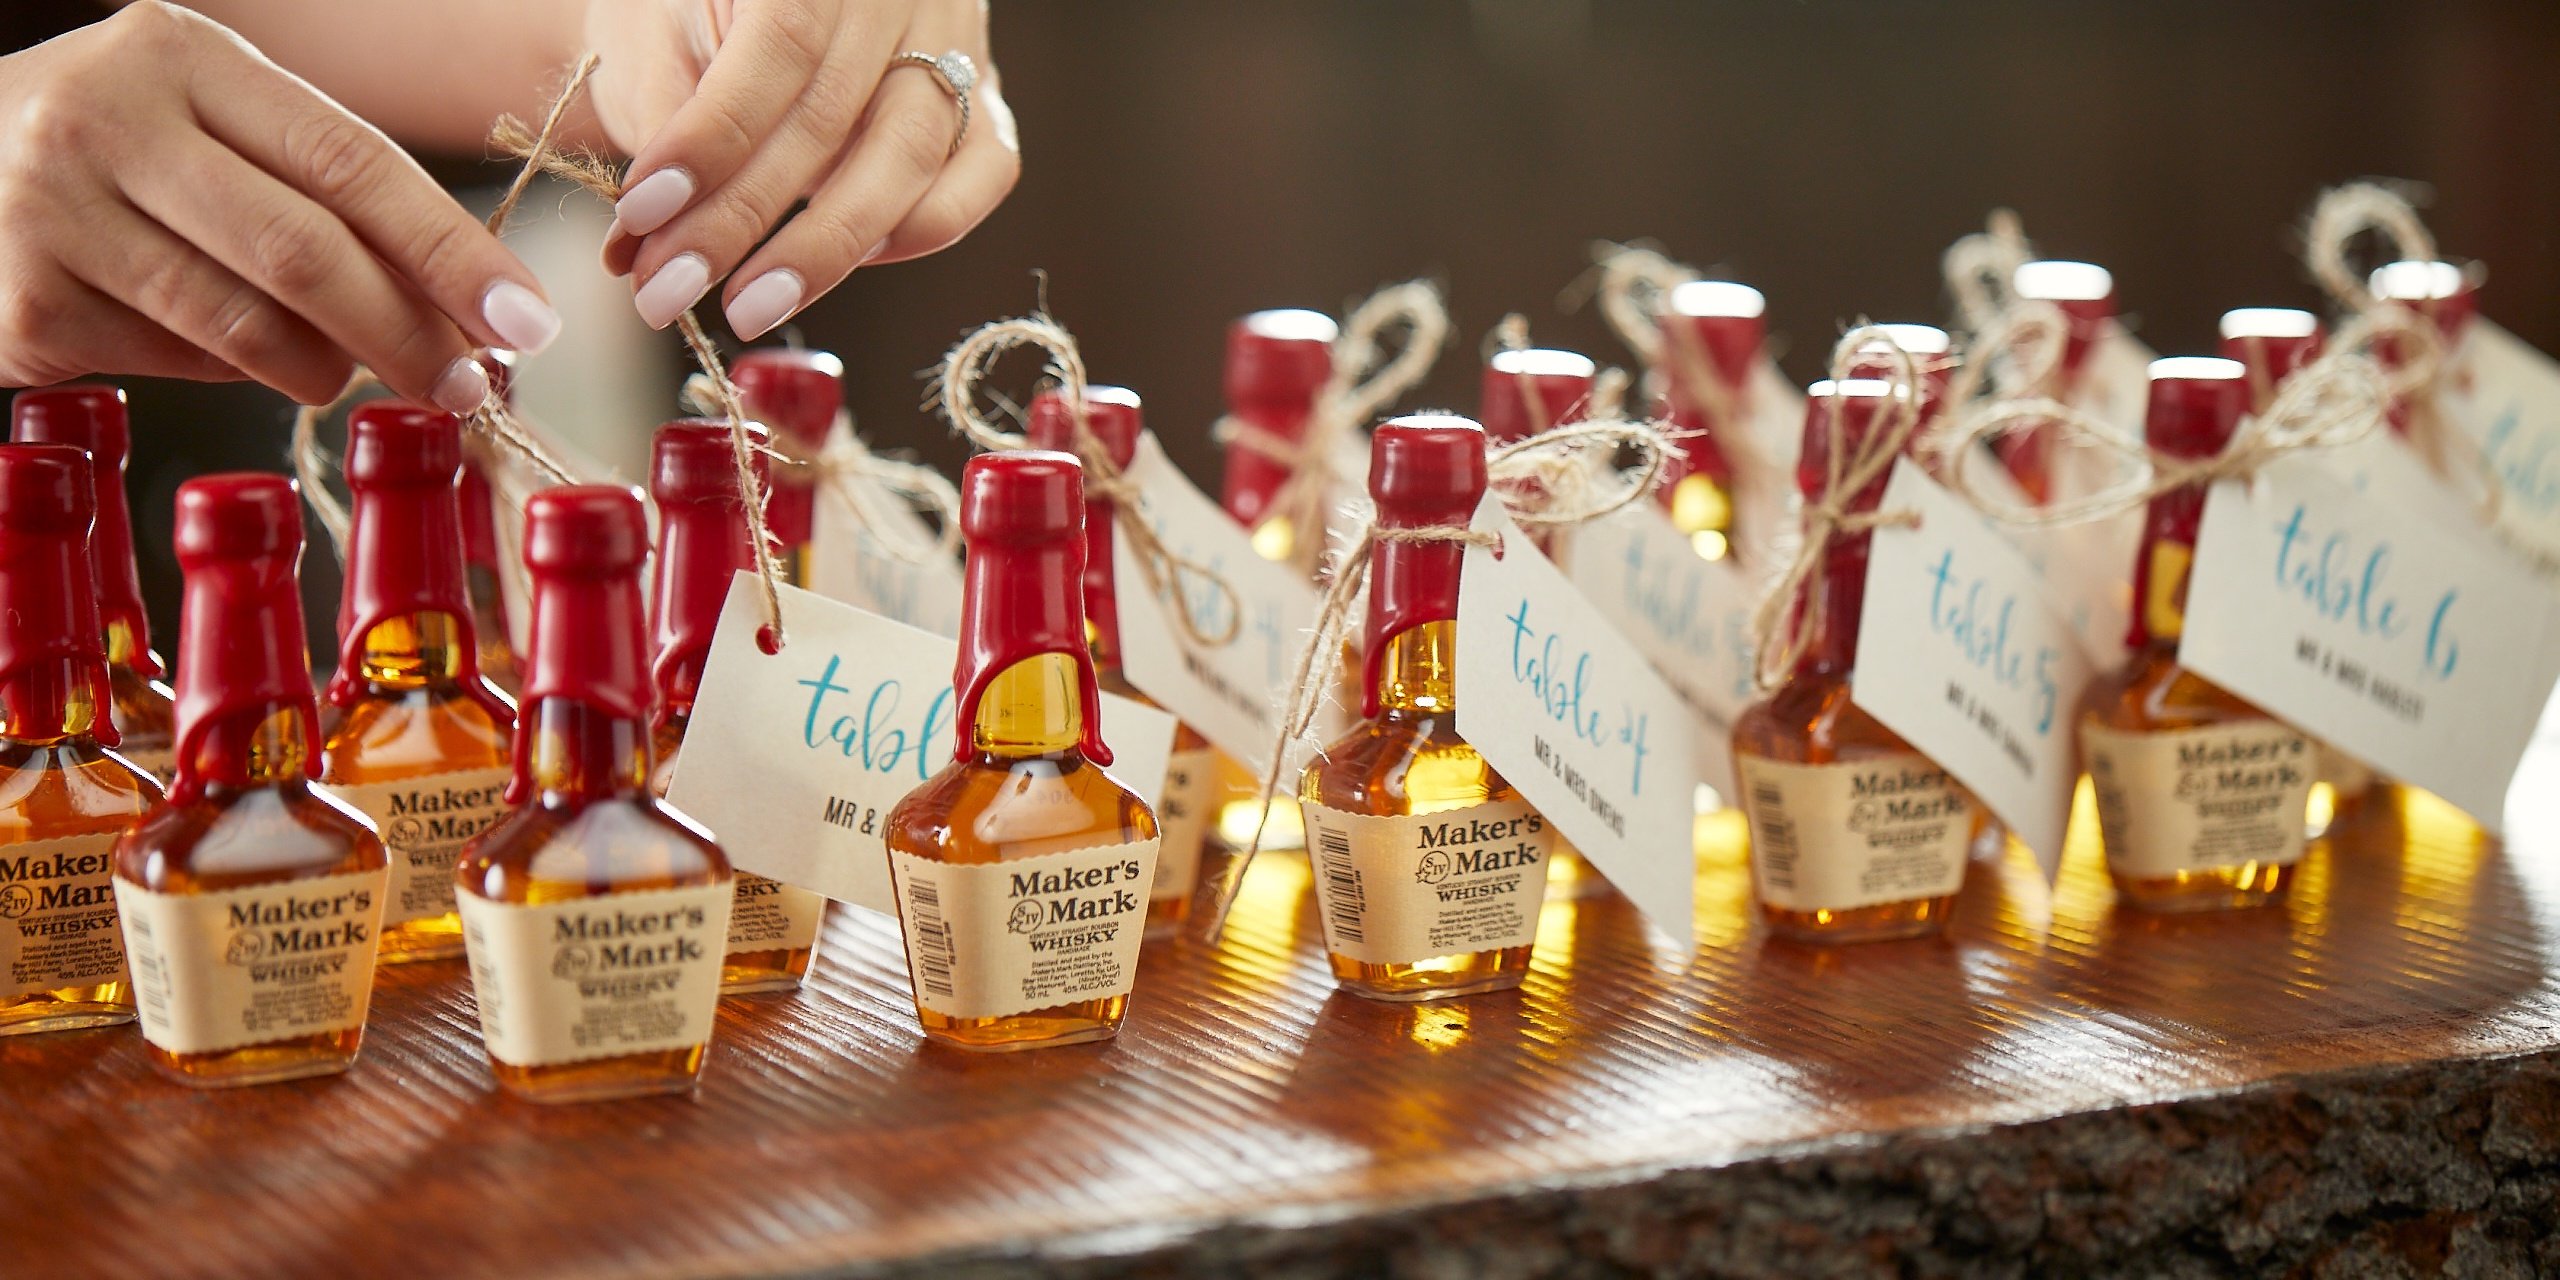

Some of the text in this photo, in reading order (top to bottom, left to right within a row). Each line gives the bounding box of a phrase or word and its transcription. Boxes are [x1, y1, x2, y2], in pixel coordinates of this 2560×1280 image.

[2275, 505, 2409, 639] table
[2424, 587, 2460, 680] 6
[1927, 549, 2022, 689] table
[1506, 598, 1648, 796] table 4
[1535, 735, 1551, 769] MR
[1565, 763, 1586, 803] MRS
[823, 796, 857, 829] MR
[860, 808, 875, 836] &
[1416, 814, 1542, 849] Maker's
[1453, 842, 1538, 876] Mark
[1008, 860, 1140, 899] Maker's
[1437, 880, 1521, 902] WHISKY
[227, 890, 371, 929] Maker's
[554, 905, 705, 942] Maker's
[1046, 889, 1135, 925] Mark
[19, 915, 116, 937] WHISKY
[270, 921, 368, 955] Mark
[1029, 921, 1119, 940] KENTUCKY STRAIGHT BOURBON
[1029, 928, 1119, 952] WHISKY
[600, 936, 703, 972] Mark
[1074, 955, 1090, 963] aged
[1107, 963, 1120, 972] USA
[1025, 992, 1036, 1000] 50
[1063, 985, 1078, 994] 45%
[1037, 981, 1066, 989] Matured
